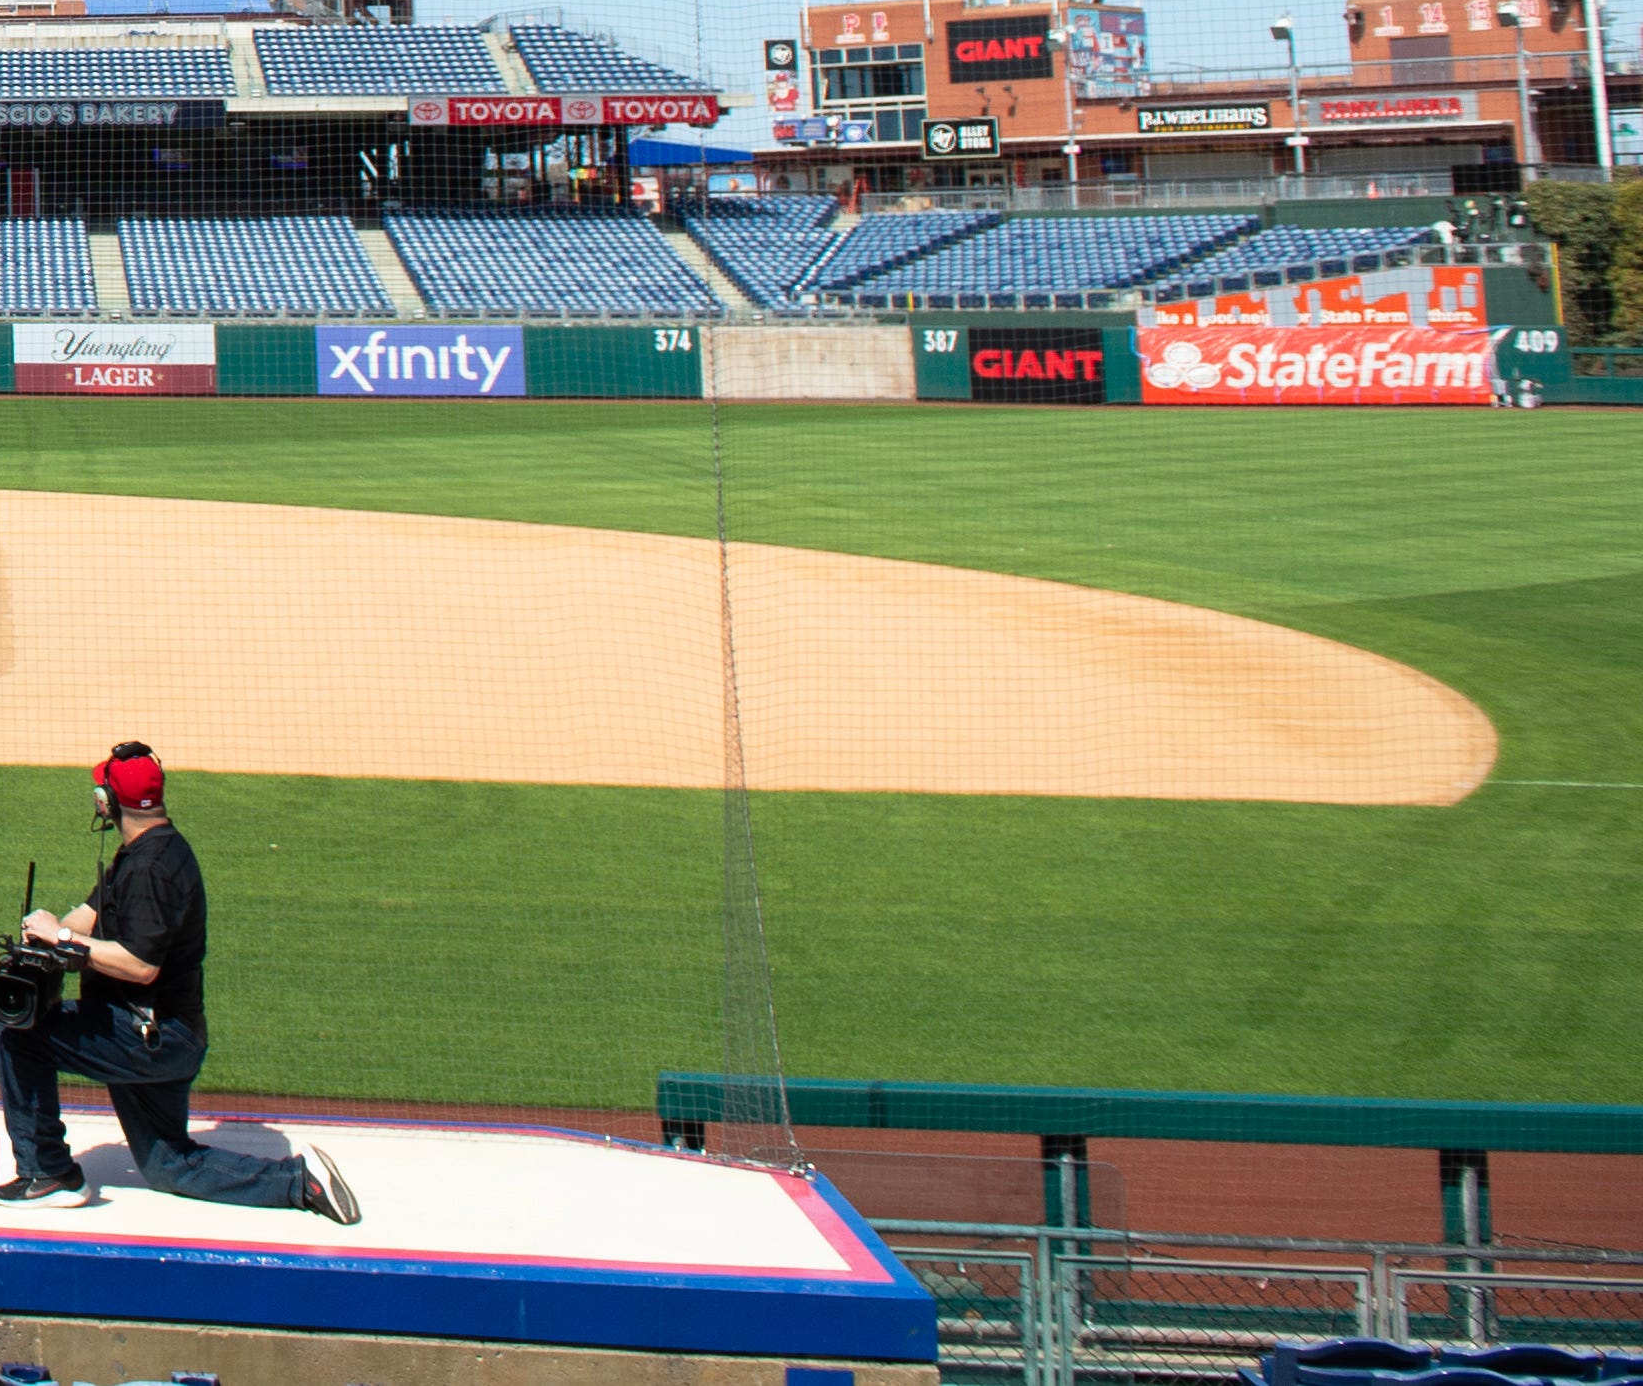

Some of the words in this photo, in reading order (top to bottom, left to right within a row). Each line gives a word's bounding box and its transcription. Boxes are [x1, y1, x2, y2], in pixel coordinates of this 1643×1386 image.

[955, 36, 1044, 63] GIANT
[80, 102, 179, 125] BAKERY
[455, 99, 557, 121] TOYOTA
[608, 98, 710, 121] TOYOTA
[1183, 313, 1195, 325] a
[1321, 310, 1361, 325] State
[1364, 309, 1407, 323] Farm
[51, 328, 178, 363] Yuengling
[654, 329, 692, 353] 374
[923, 330, 958, 352] 387
[1514, 329, 1560, 353] 409
[329, 331, 510, 392] xfinity
[973, 349, 1103, 380] GIANT
[74, 366, 155, 387] LAGER
